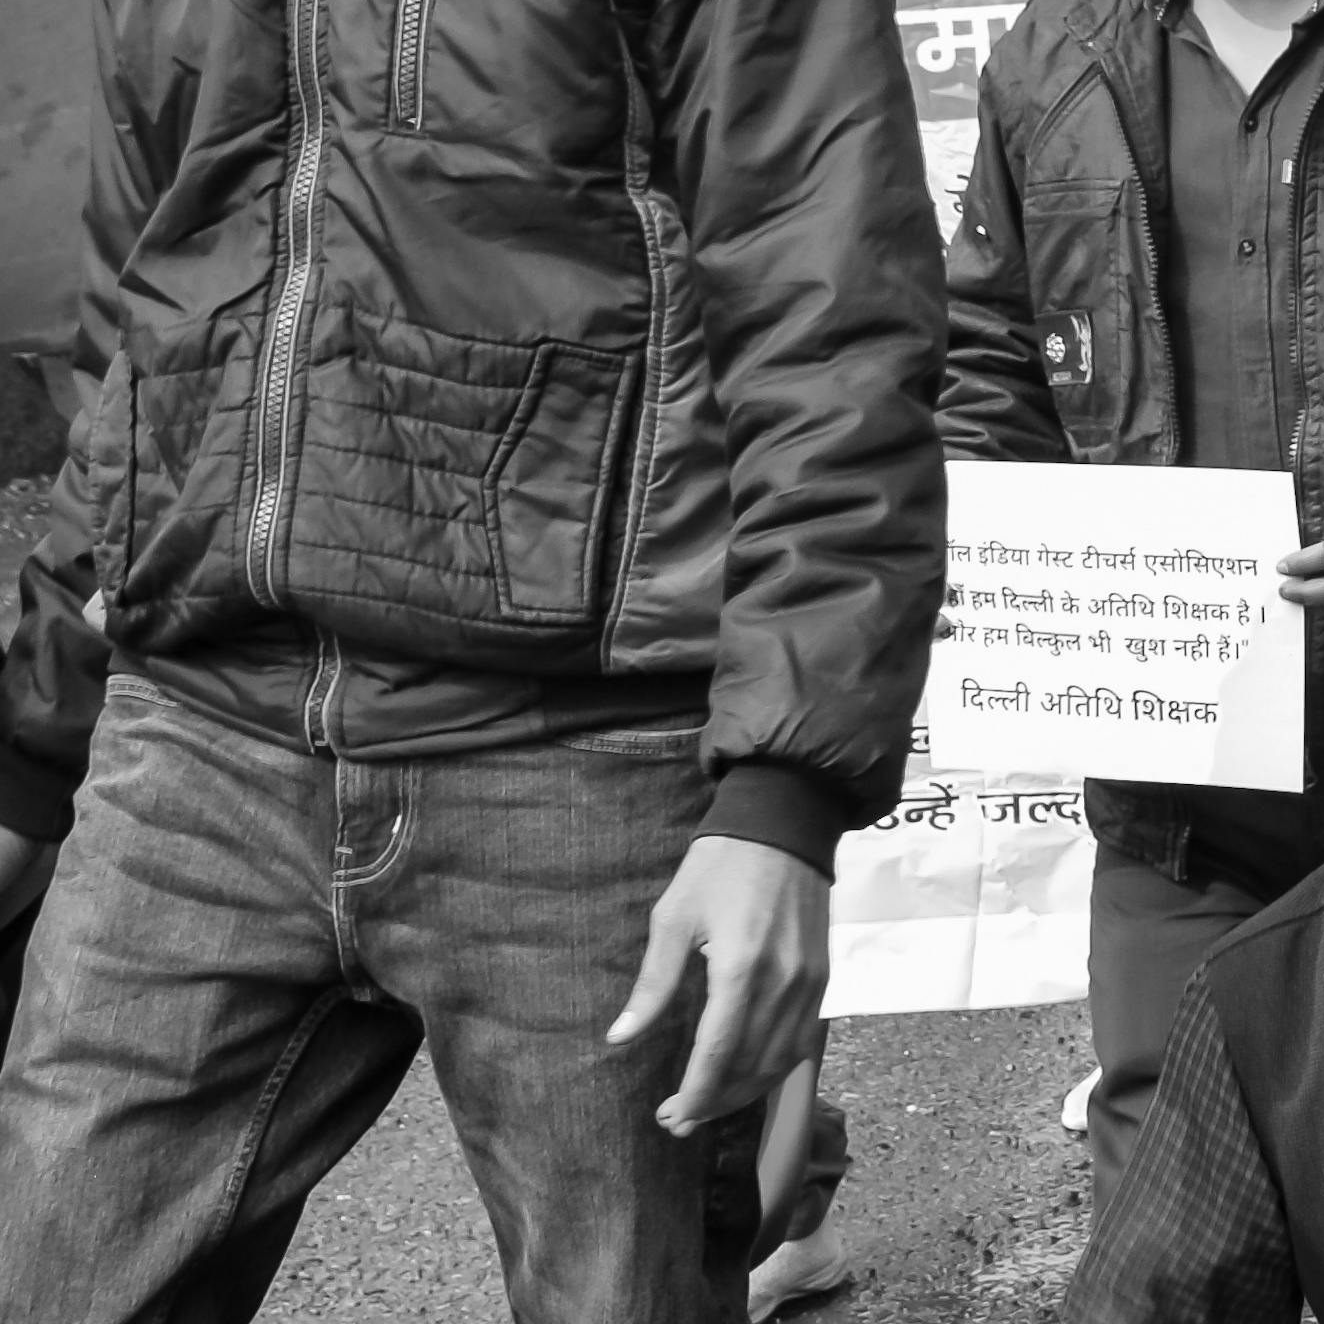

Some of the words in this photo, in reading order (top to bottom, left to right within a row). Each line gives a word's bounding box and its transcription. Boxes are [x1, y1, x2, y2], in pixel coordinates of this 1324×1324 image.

[978, 541, 1029, 565] इंडिया
[1037, 543, 1072, 567] गेस्ट
[1081, 546, 1135, 570] टीचर्स
[1144, 549, 1257, 578] एसोसिएशन
[970, 591, 996, 610] हम
[1002, 587, 1053, 612] दिल्ली
[1061, 591, 1079, 613] के
[1088, 593, 1154, 617] अतिथि
[1163, 595, 1229, 620] शिक्षक
[1237, 599, 1249, 625] है
[983, 628, 1008, 647] हम
[1089, 630, 1111, 652] भी
[1125, 638, 1165, 662] खुश
[961, 678, 1030, 712] दिल्ली
[1041, 686, 1122, 719] अतिथि
[1132, 690, 1218, 723] शिक्षक
[977, 792, 1081, 825] जल्द
